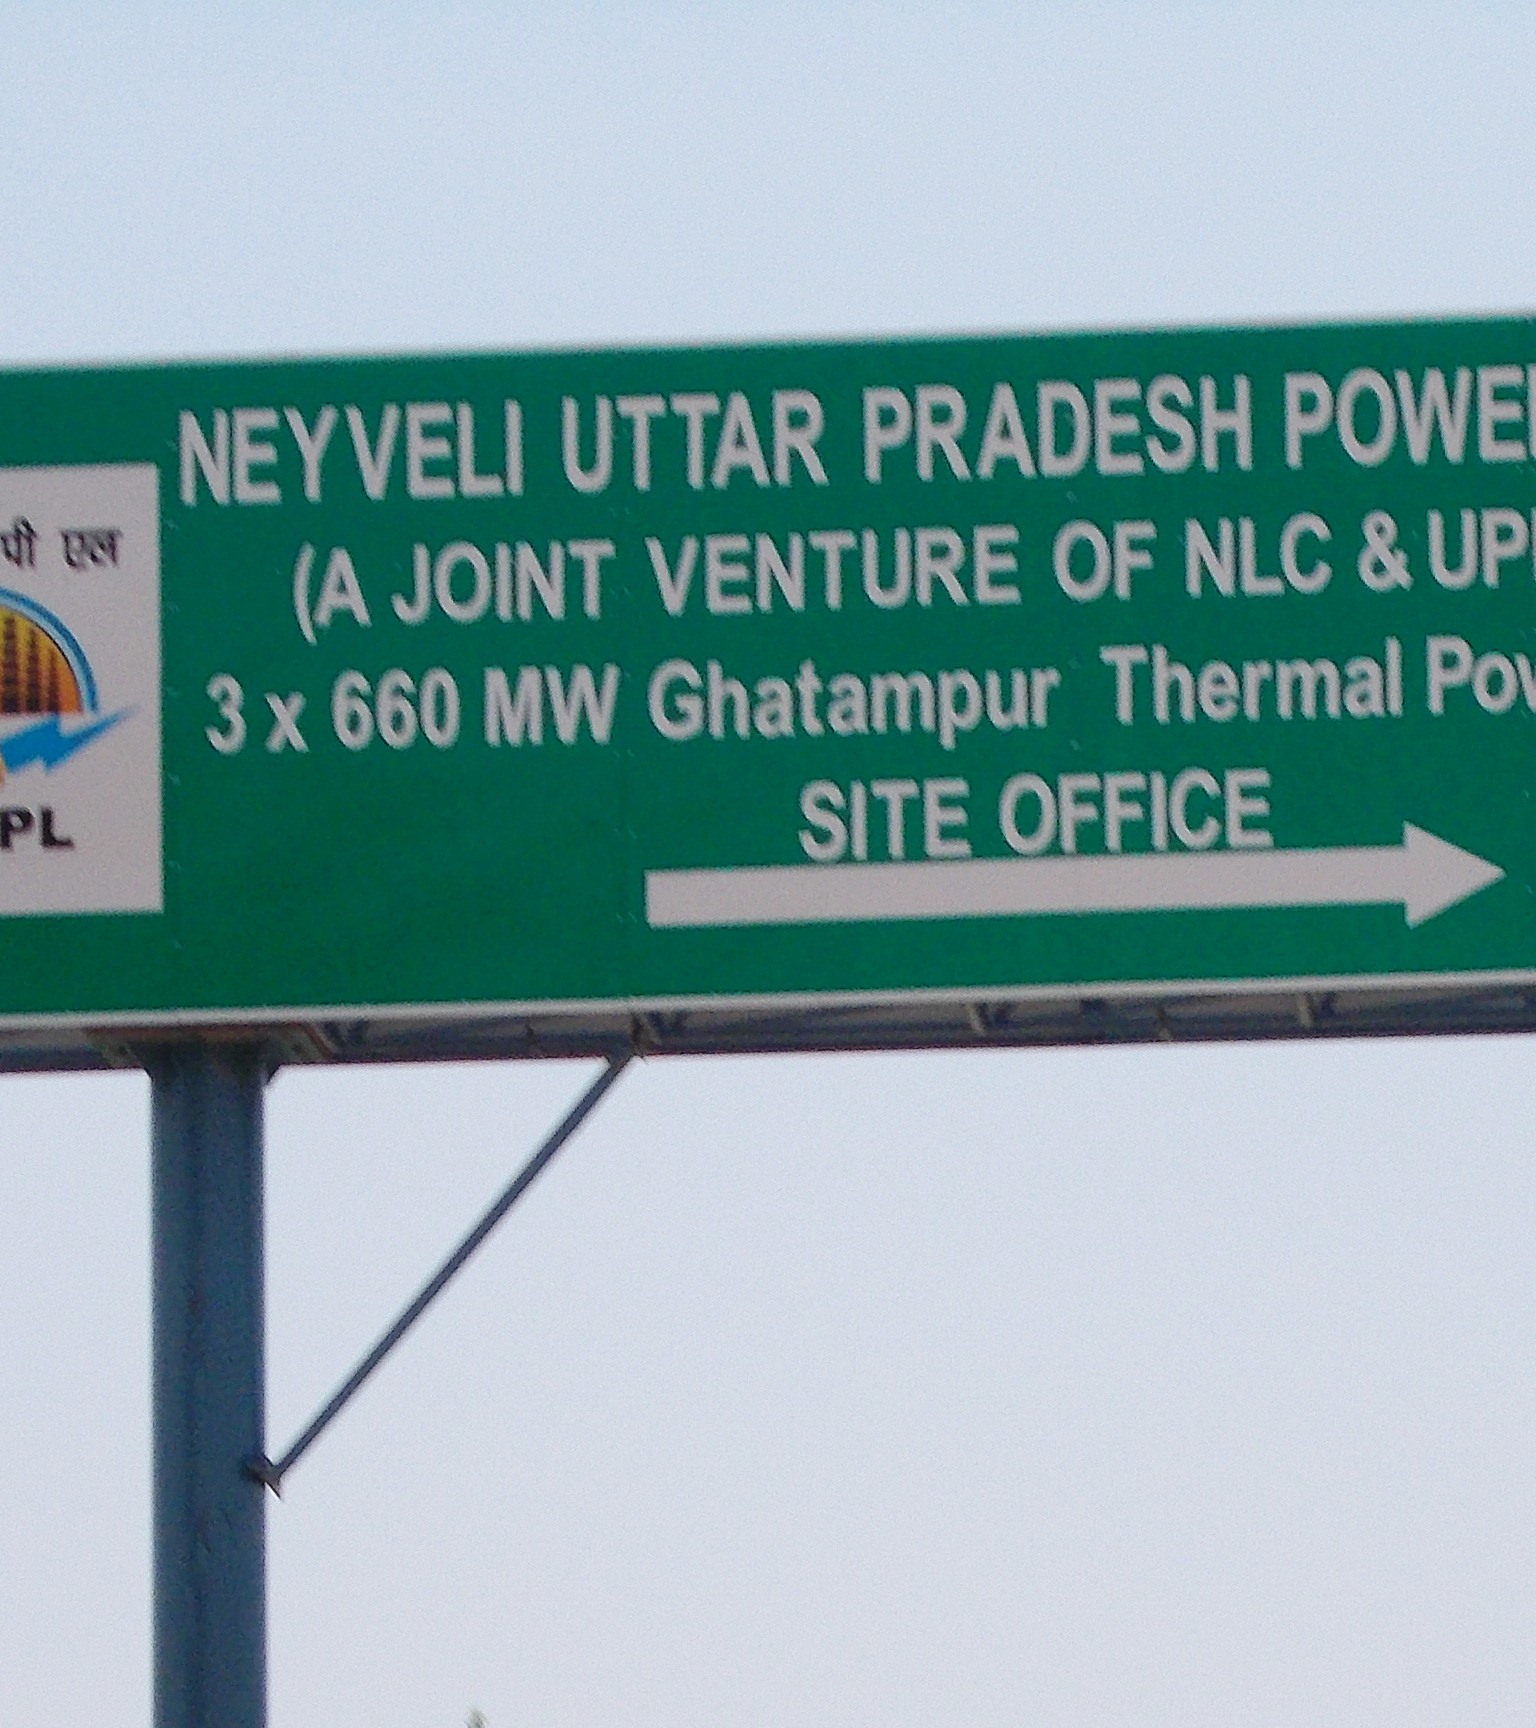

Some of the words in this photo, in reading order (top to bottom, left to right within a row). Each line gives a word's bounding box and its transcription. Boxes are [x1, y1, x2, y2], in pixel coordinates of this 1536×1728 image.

[178, 399, 525, 505] NEYVELI
[560, 389, 829, 493] UTTAR
[863, 374, 1254, 483] PRADESH
[293, 544, 371, 644] (A
[391, 538, 616, 625] JOINT
[645, 524, 1021, 615] VENTURE
[1052, 518, 1158, 601] OF
[1185, 512, 1333, 596] NLC
[1357, 510, 1413, 592] &
[205, 672, 247, 754] 3
[265, 692, 310, 752] x
[332, 667, 461, 750] 660
[484, 664, 619, 747] MW
[647, 656, 1061, 750] Ghatampur
[1099, 637, 1404, 724] Thermal
[796, 778, 973, 864] SITE
[996, 766, 1274, 857] OFFICE
